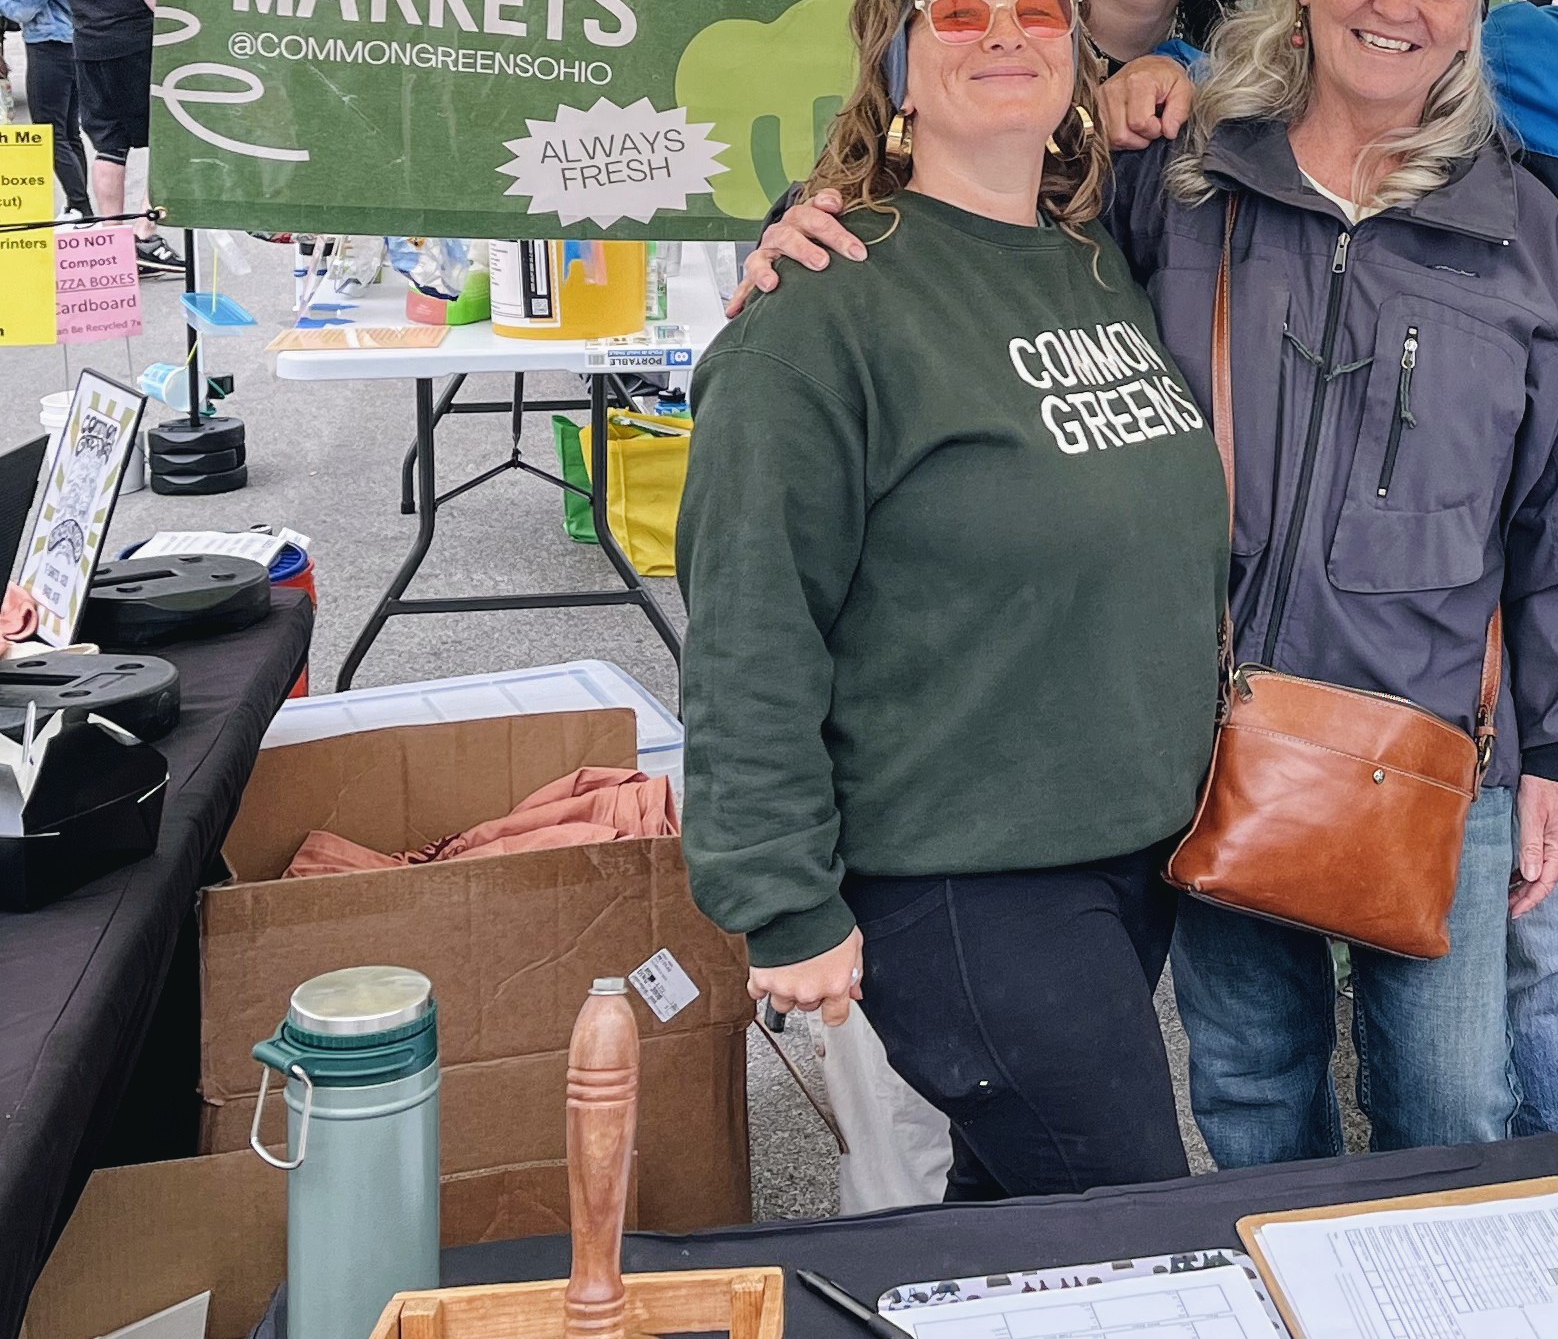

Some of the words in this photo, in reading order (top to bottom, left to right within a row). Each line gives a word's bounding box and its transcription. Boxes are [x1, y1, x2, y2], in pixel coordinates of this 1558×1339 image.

[228, 33, 613, 86] @COMMONGREENSOHIO
[15, 131, 42, 143] Me
[541, 129, 686, 164] ALWAYS
[1, 175, 45, 186] boxes
[561, 158, 672, 191] FRESH
[0, 238, 47, 249] rinters
[58, 238, 79, 250] DO
[84, 234, 115, 248] NOT
[59, 256, 118, 271] Compost
[56, 278, 87, 291] IZZA
[90, 273, 135, 287] BOXES
[1008, 321, 1167, 389] COMMON
[1041, 376, 1202, 455] GREENS
